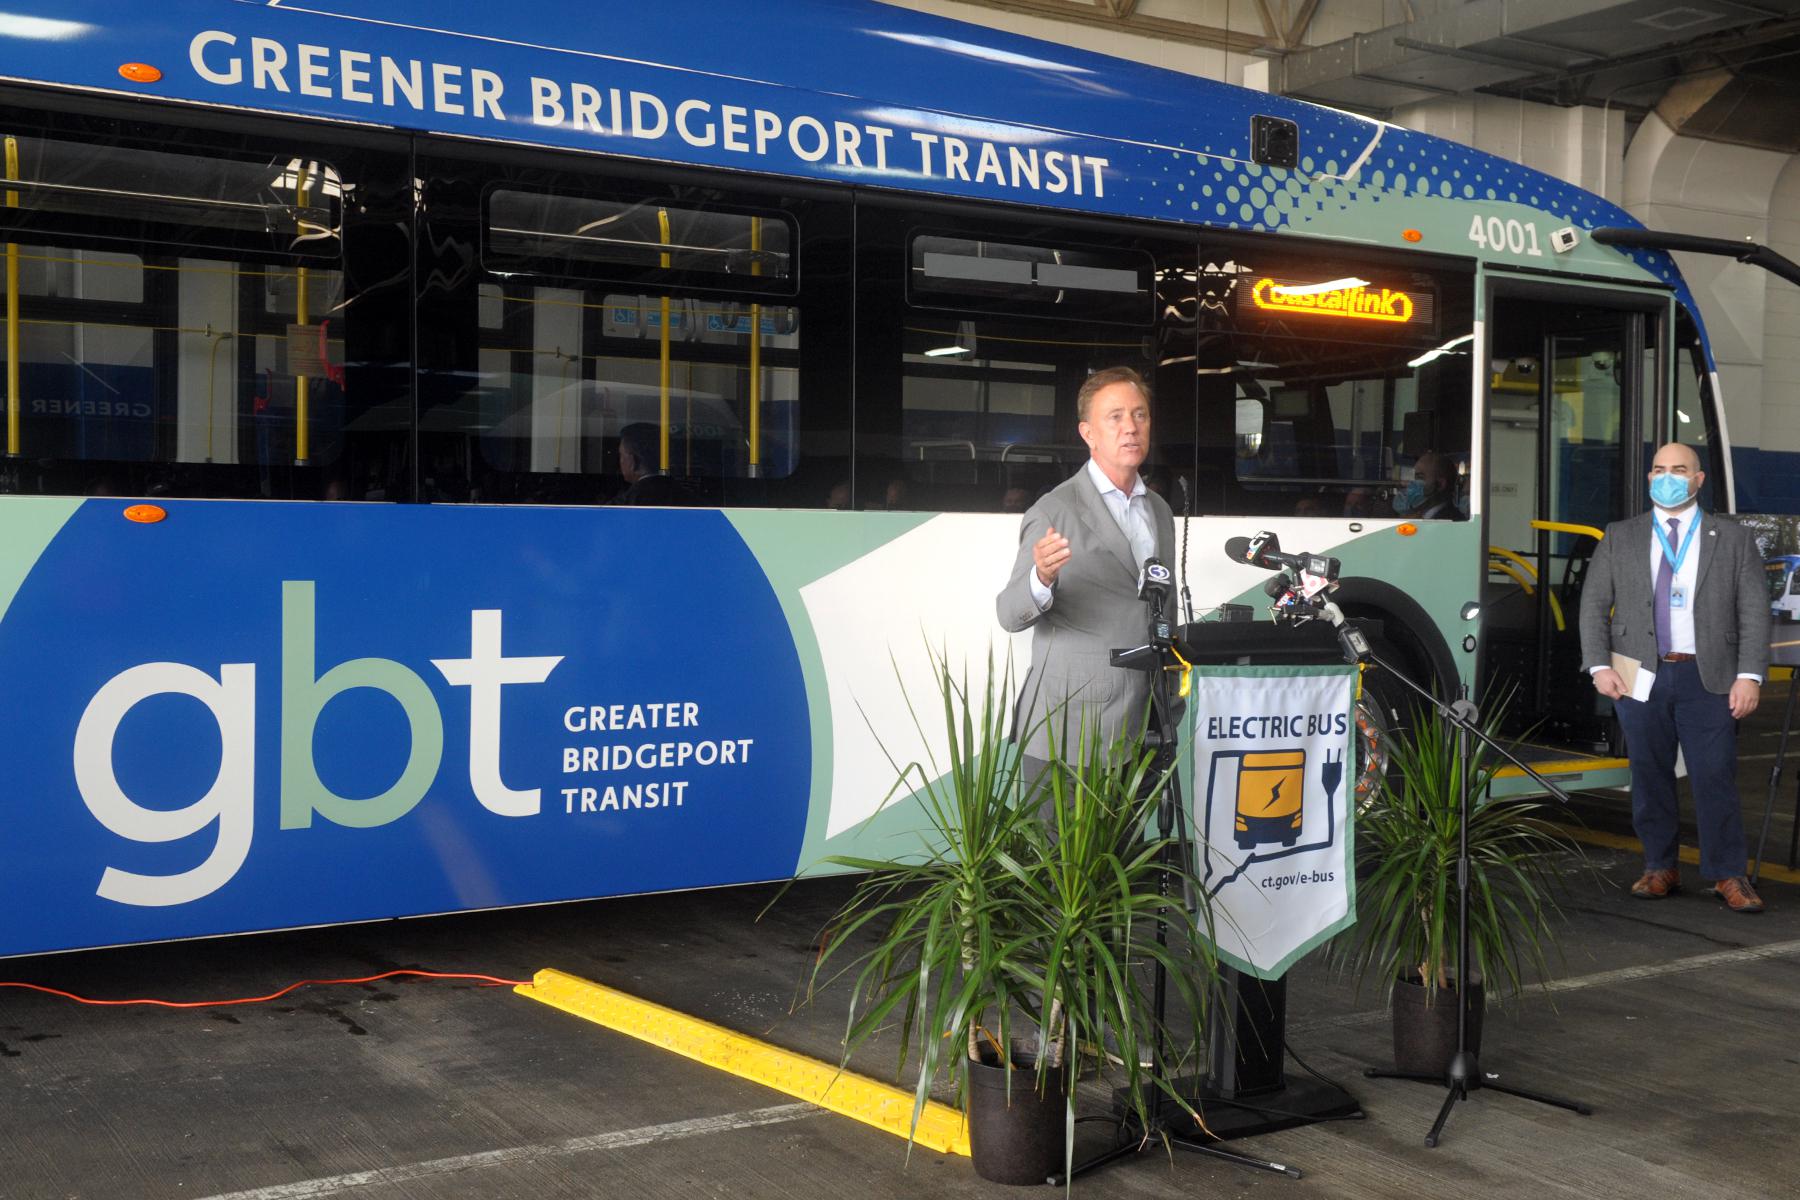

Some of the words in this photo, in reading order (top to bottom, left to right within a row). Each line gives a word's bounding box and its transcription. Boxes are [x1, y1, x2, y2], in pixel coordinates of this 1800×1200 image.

[188, 30, 506, 122] GREENER
[530, 76, 894, 171] BRIDGEPORT
[911, 132, 1109, 199] TRANSIT
[1468, 214, 1542, 257] 4001
[563, 702, 700, 733] GREATER
[1207, 714, 1301, 740] ELECTRIC
[1306, 712, 1347, 736] BUS
[73, 580, 566, 907] gbt
[562, 739, 754, 773] BRIDGEPORT
[561, 781, 690, 814] TRANSIT
[1261, 869, 1335, 889] ct.gov/e-bus
